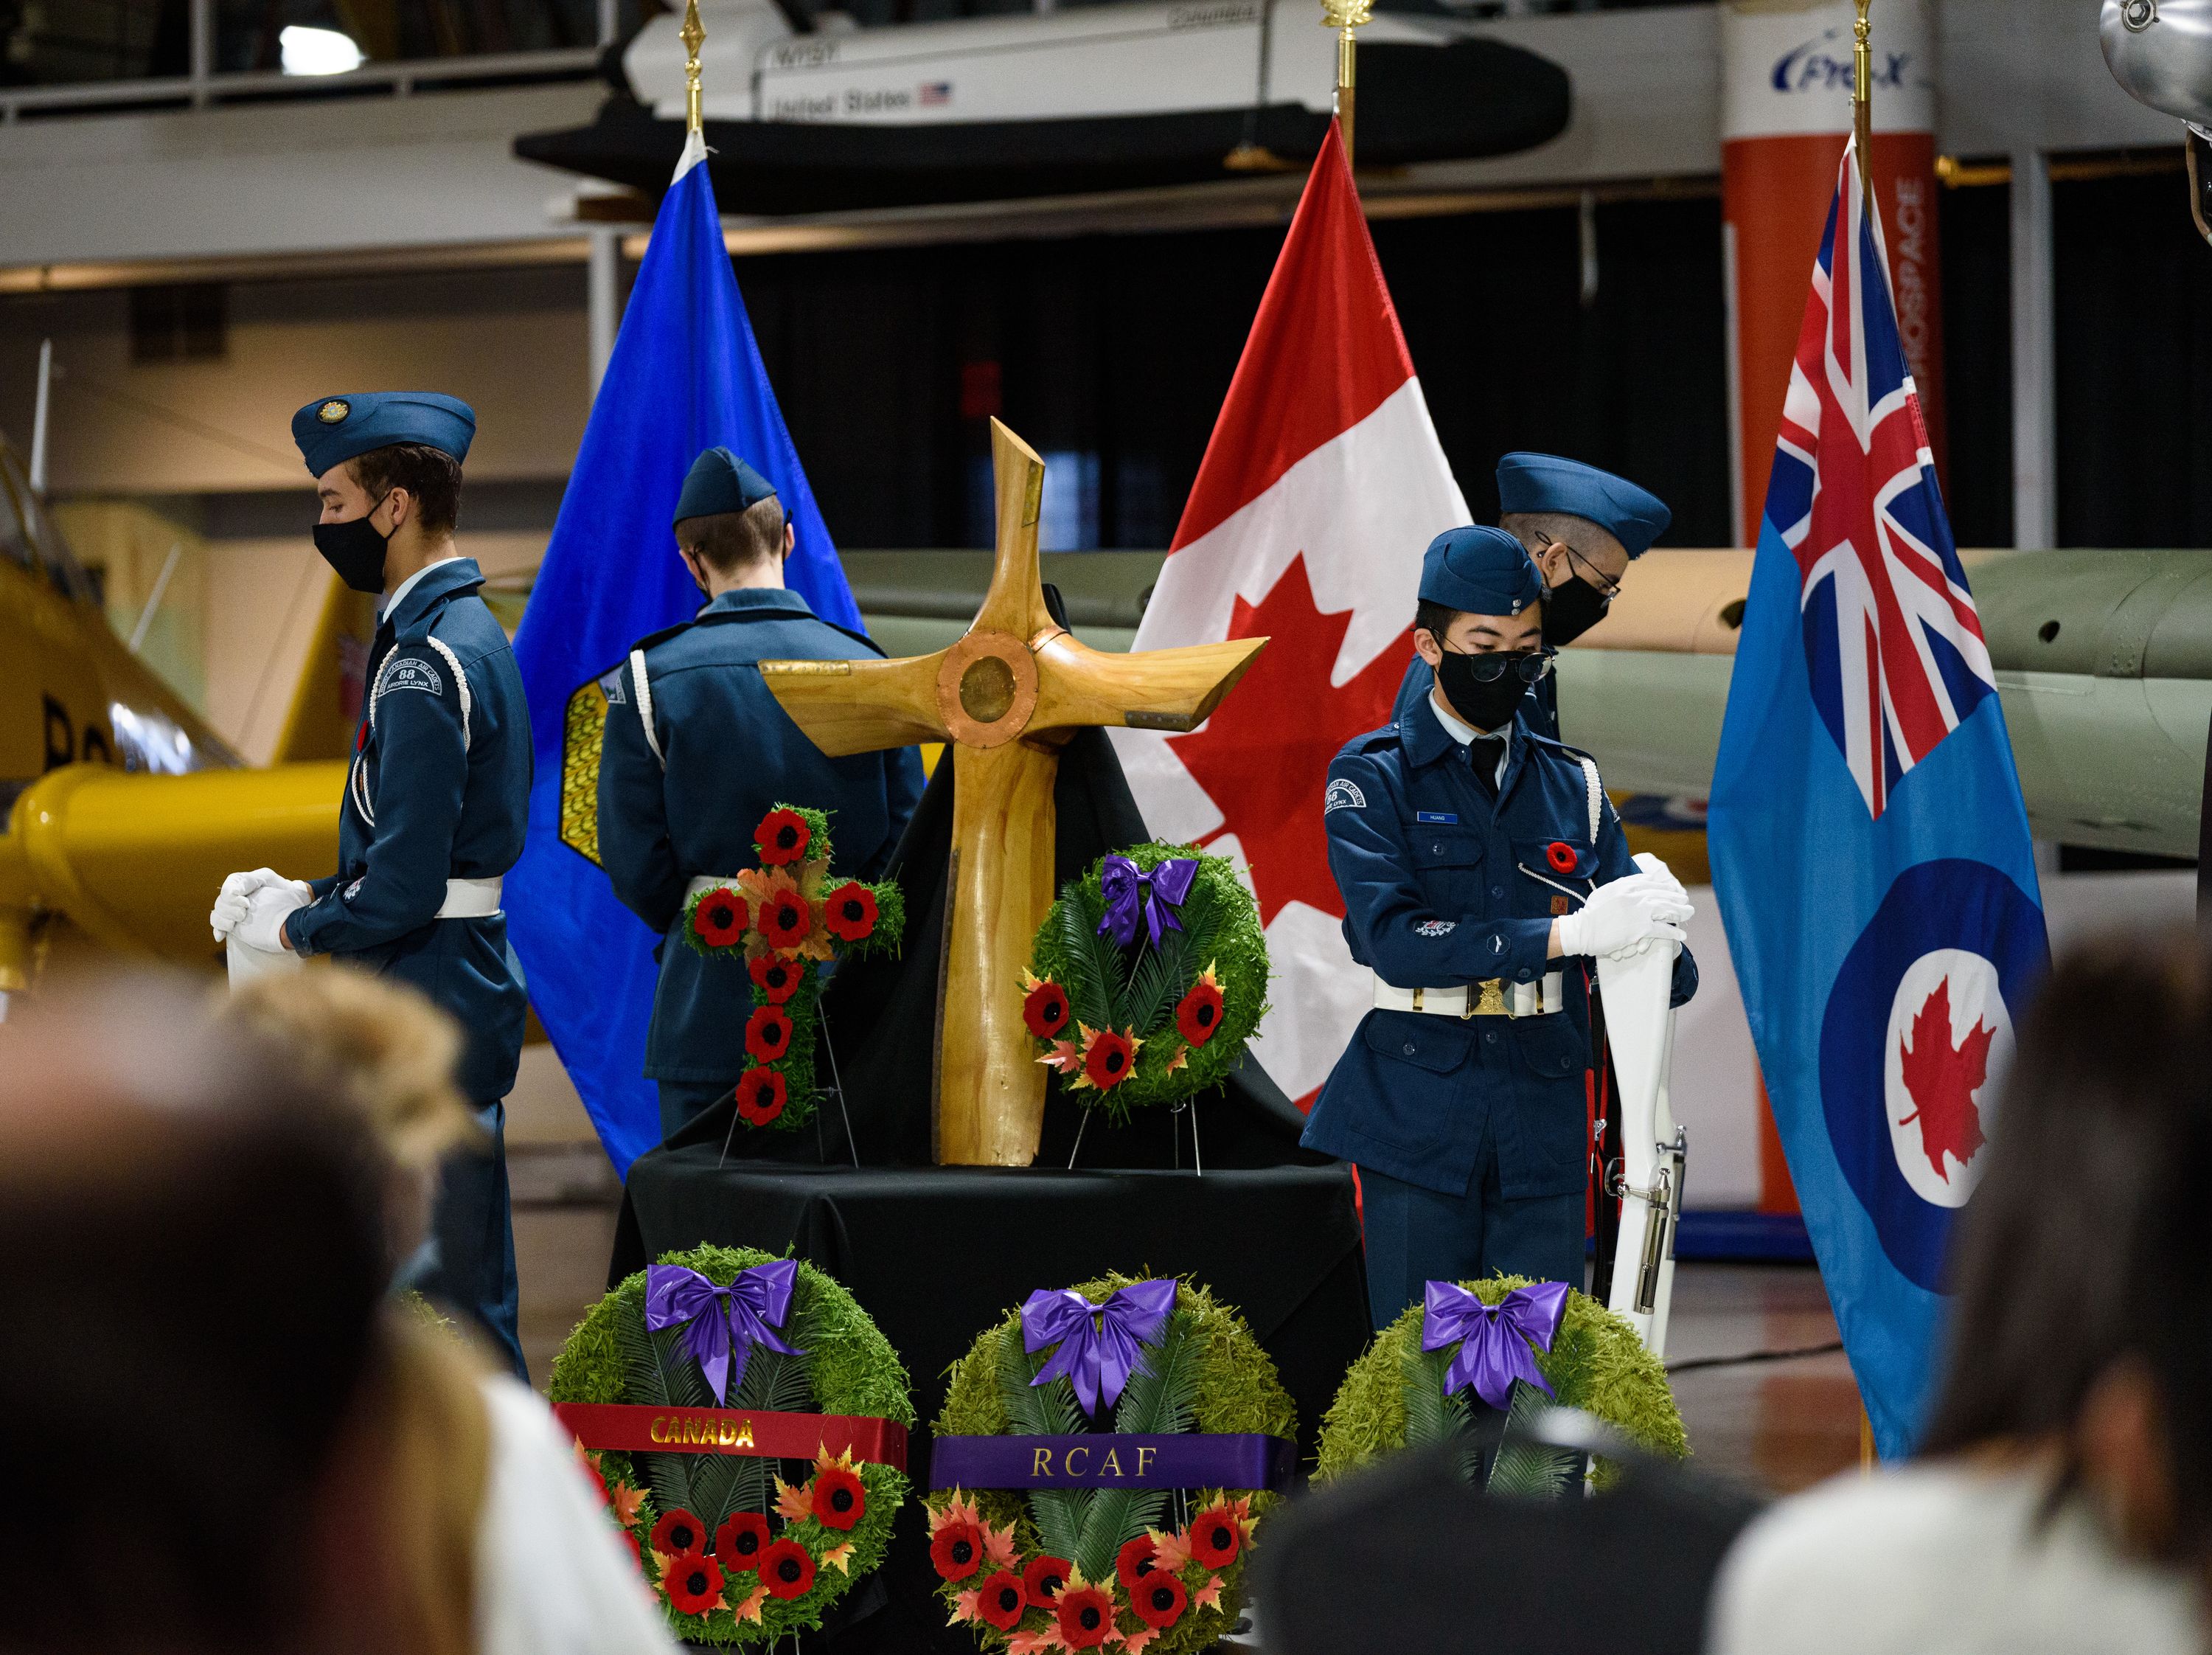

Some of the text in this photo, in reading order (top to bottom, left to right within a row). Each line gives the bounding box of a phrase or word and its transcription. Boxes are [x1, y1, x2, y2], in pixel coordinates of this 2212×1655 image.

[846, 89, 911, 111] States
[387, 680, 409, 690] AIRDRIE
[389, 660, 417, 674] CANADIAN
[418, 663, 428, 671] AIR
[428, 670, 440, 690] CADETS
[399, 670, 415, 679] 88
[1349, 785, 1363, 805] CADETS
[650, 1415, 754, 1448] CANADA
[1030, 1446, 1157, 1477] RCAF
